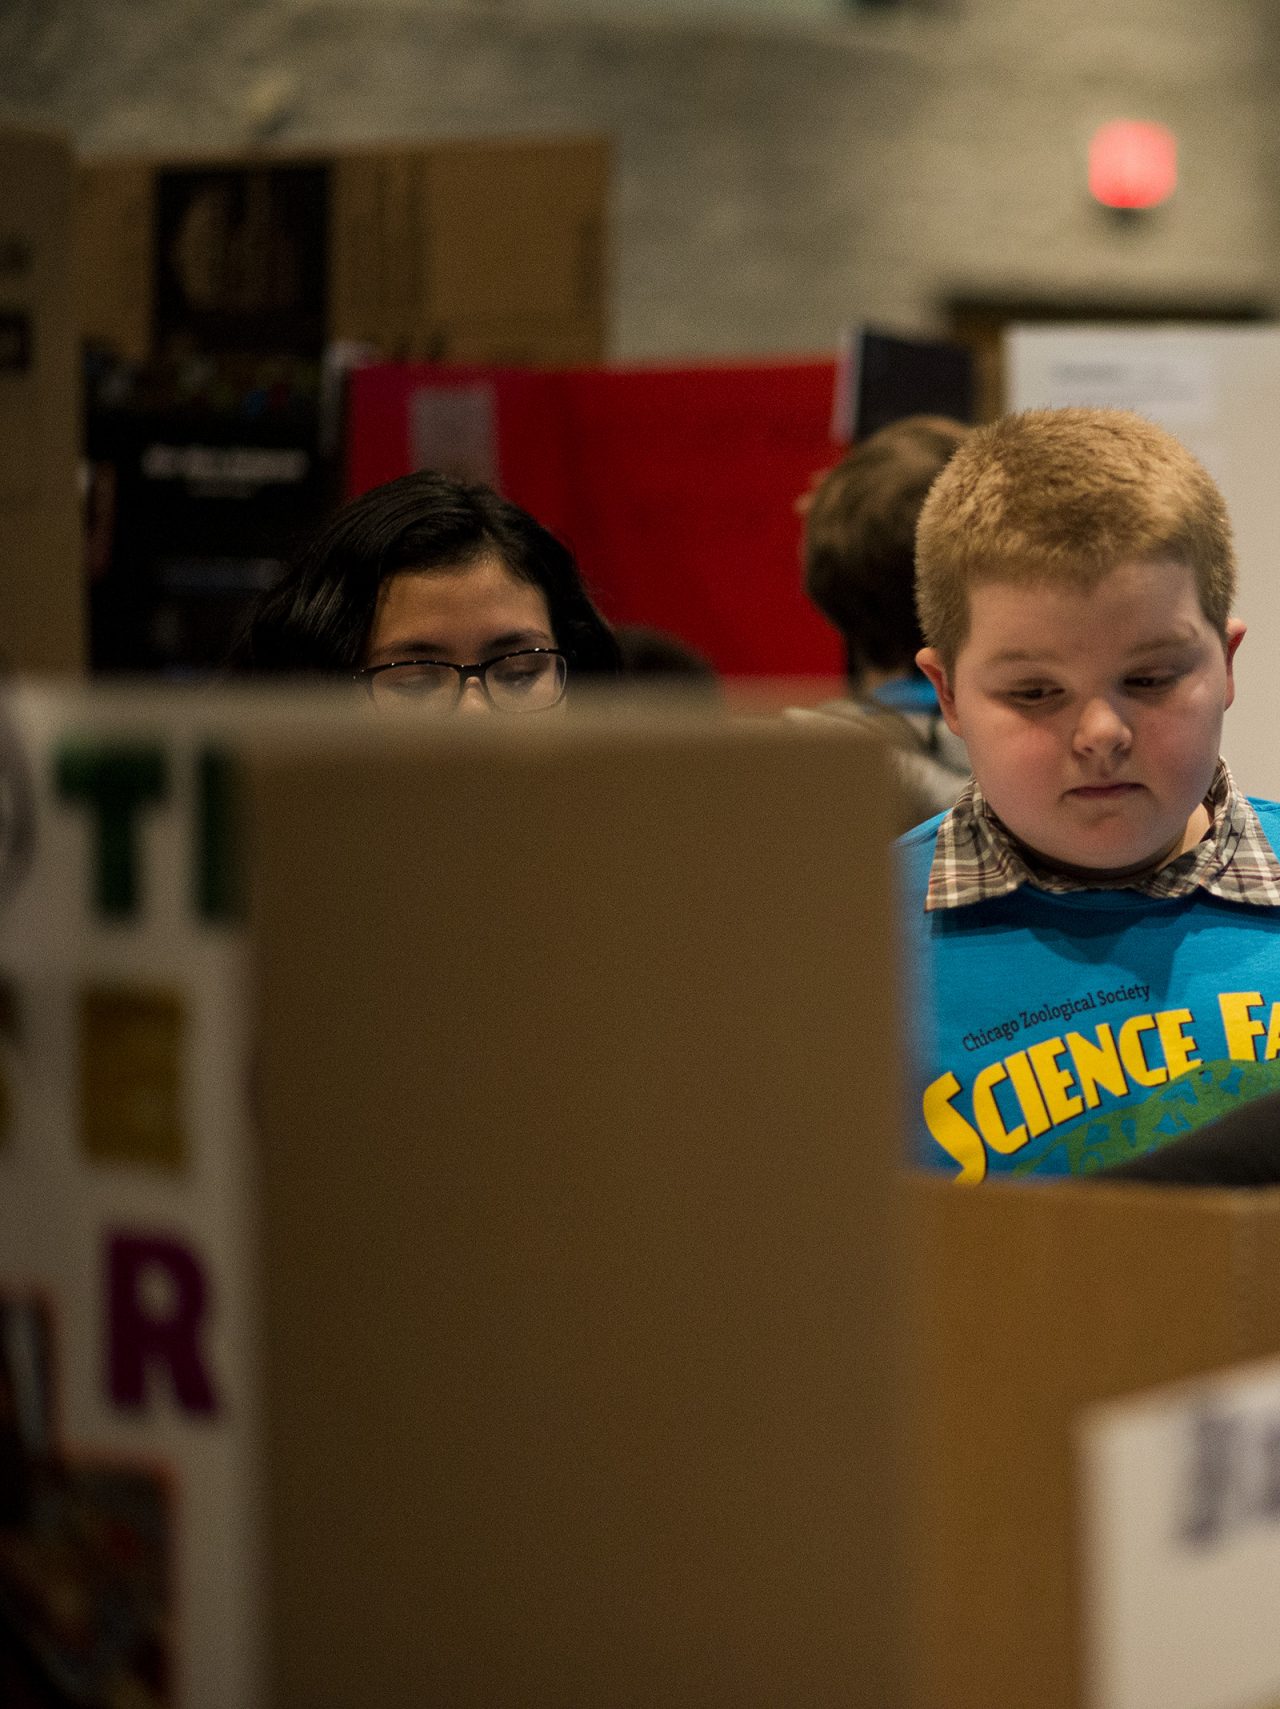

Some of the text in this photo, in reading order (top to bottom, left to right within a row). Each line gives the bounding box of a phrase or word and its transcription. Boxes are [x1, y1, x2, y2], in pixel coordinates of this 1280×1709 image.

[962, 983, 1152, 1052] Chicago Zoological Society
[922, 1008, 1204, 1186] SCIENCE
